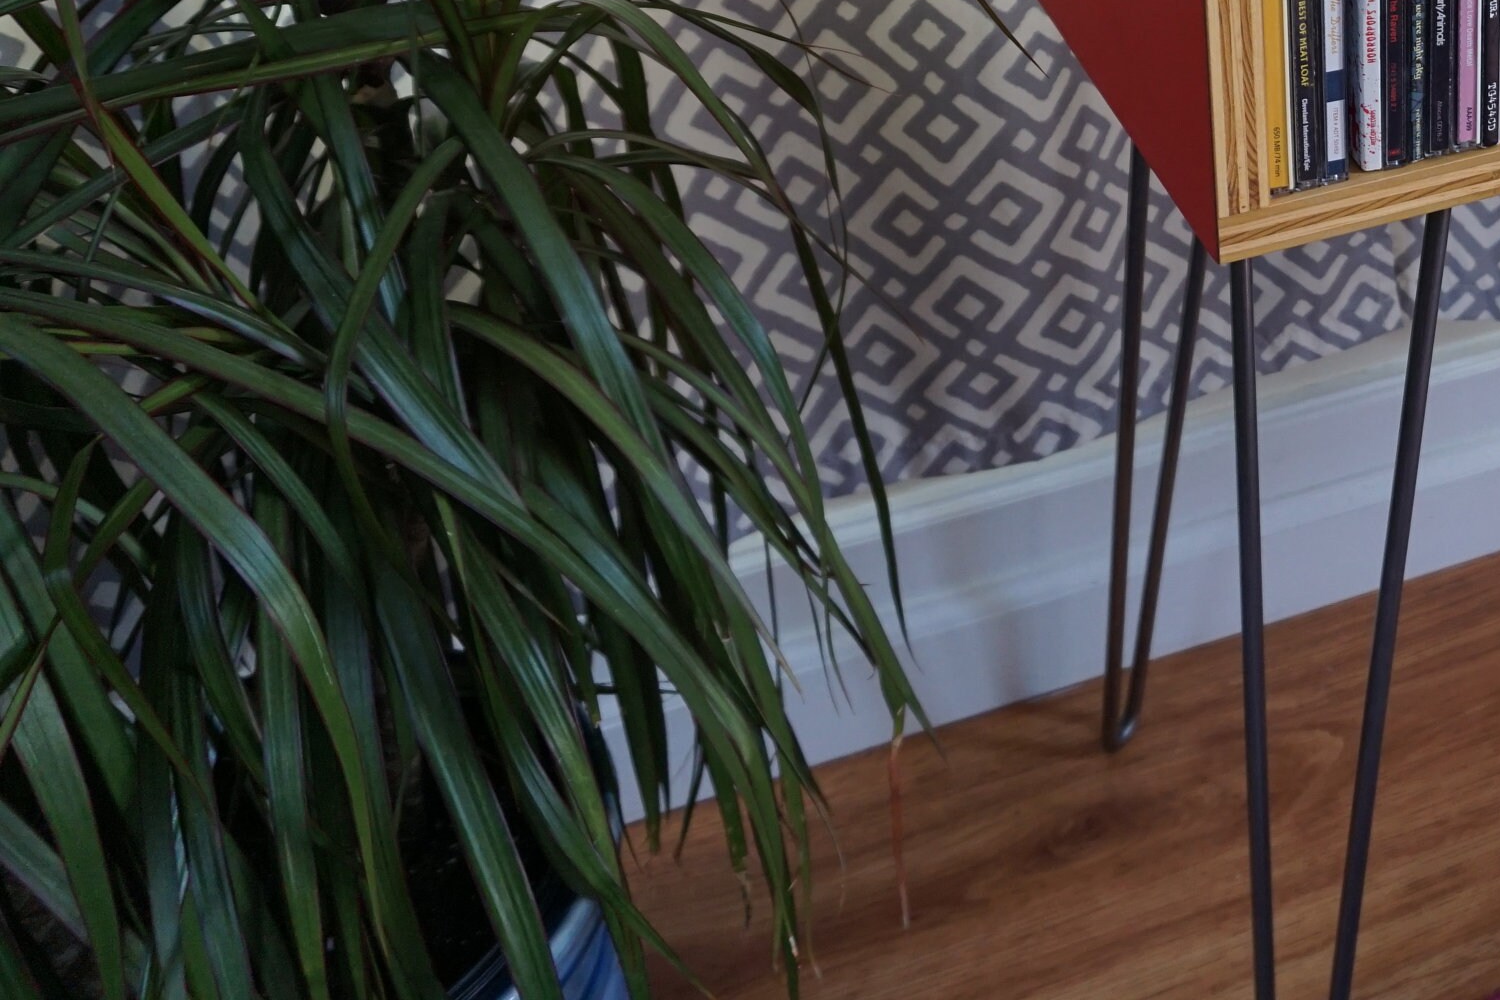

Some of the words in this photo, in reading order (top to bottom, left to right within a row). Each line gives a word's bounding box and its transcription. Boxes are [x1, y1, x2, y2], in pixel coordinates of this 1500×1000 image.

[1298, 0, 1306, 20] BEST
[1415, 4, 1422, 18] we
[1466, 10, 1474, 27] Love
[1299, 22, 1307, 34] OF
[1328, 16, 1340, 54] Drifters
[1366, 9, 1378, 64] HORRORPOPS
[1390, 14, 1398, 43] Raven
[1466, 28, 1474, 47] Death
[1300, 38, 1308, 62] MEAT
[1413, 38, 1424, 61] night
[1466, 48, 1474, 67] Metal
[1300, 64, 1309, 86] LOAF
[1414, 63, 1424, 80] sky
[1302, 98, 1310, 124] Cleveland
[1487, 82, 1498, 132] TG454CD
[1274, 140, 1282, 164] MB/74
[1274, 164, 1282, 178] min
